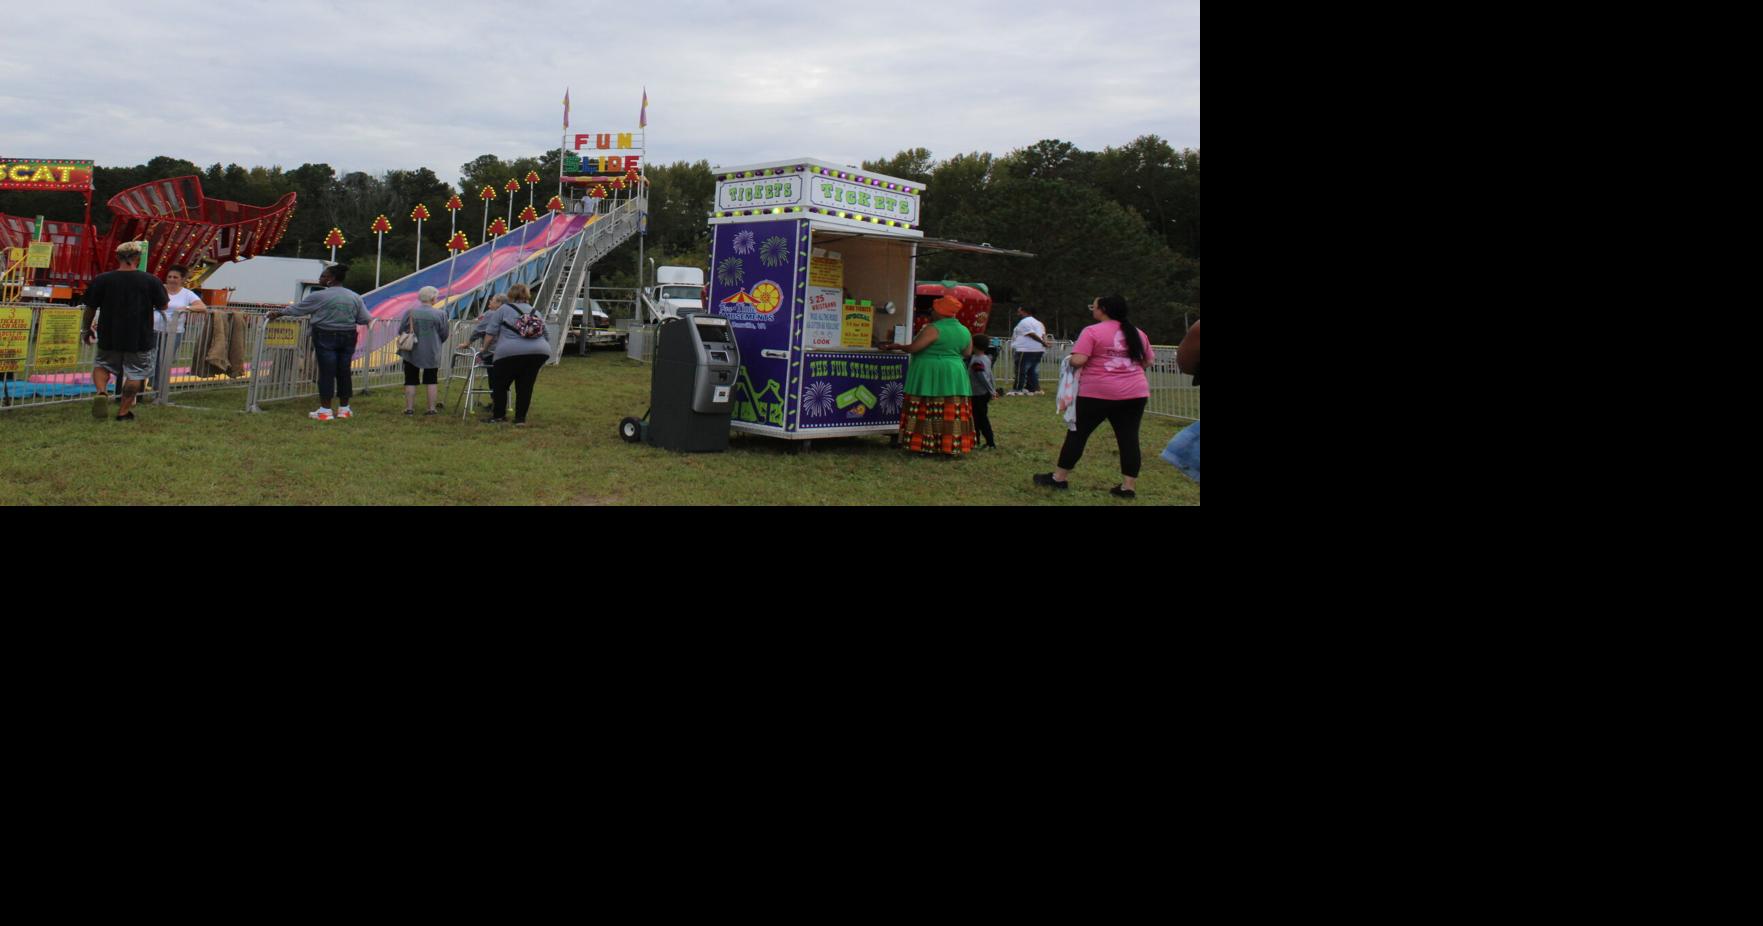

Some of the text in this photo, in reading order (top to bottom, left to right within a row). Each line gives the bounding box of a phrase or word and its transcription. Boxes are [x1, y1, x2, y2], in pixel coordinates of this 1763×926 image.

[575, 133, 632, 150] FUN
[565, 155, 640, 173] SLIDE
[729, 183, 793, 201] TICKETS
[820, 183, 910, 214] TICKETS
[810, 360, 829, 378] THE
[830, 360, 848, 377] FUN
[849, 362, 879, 380] STARTS
